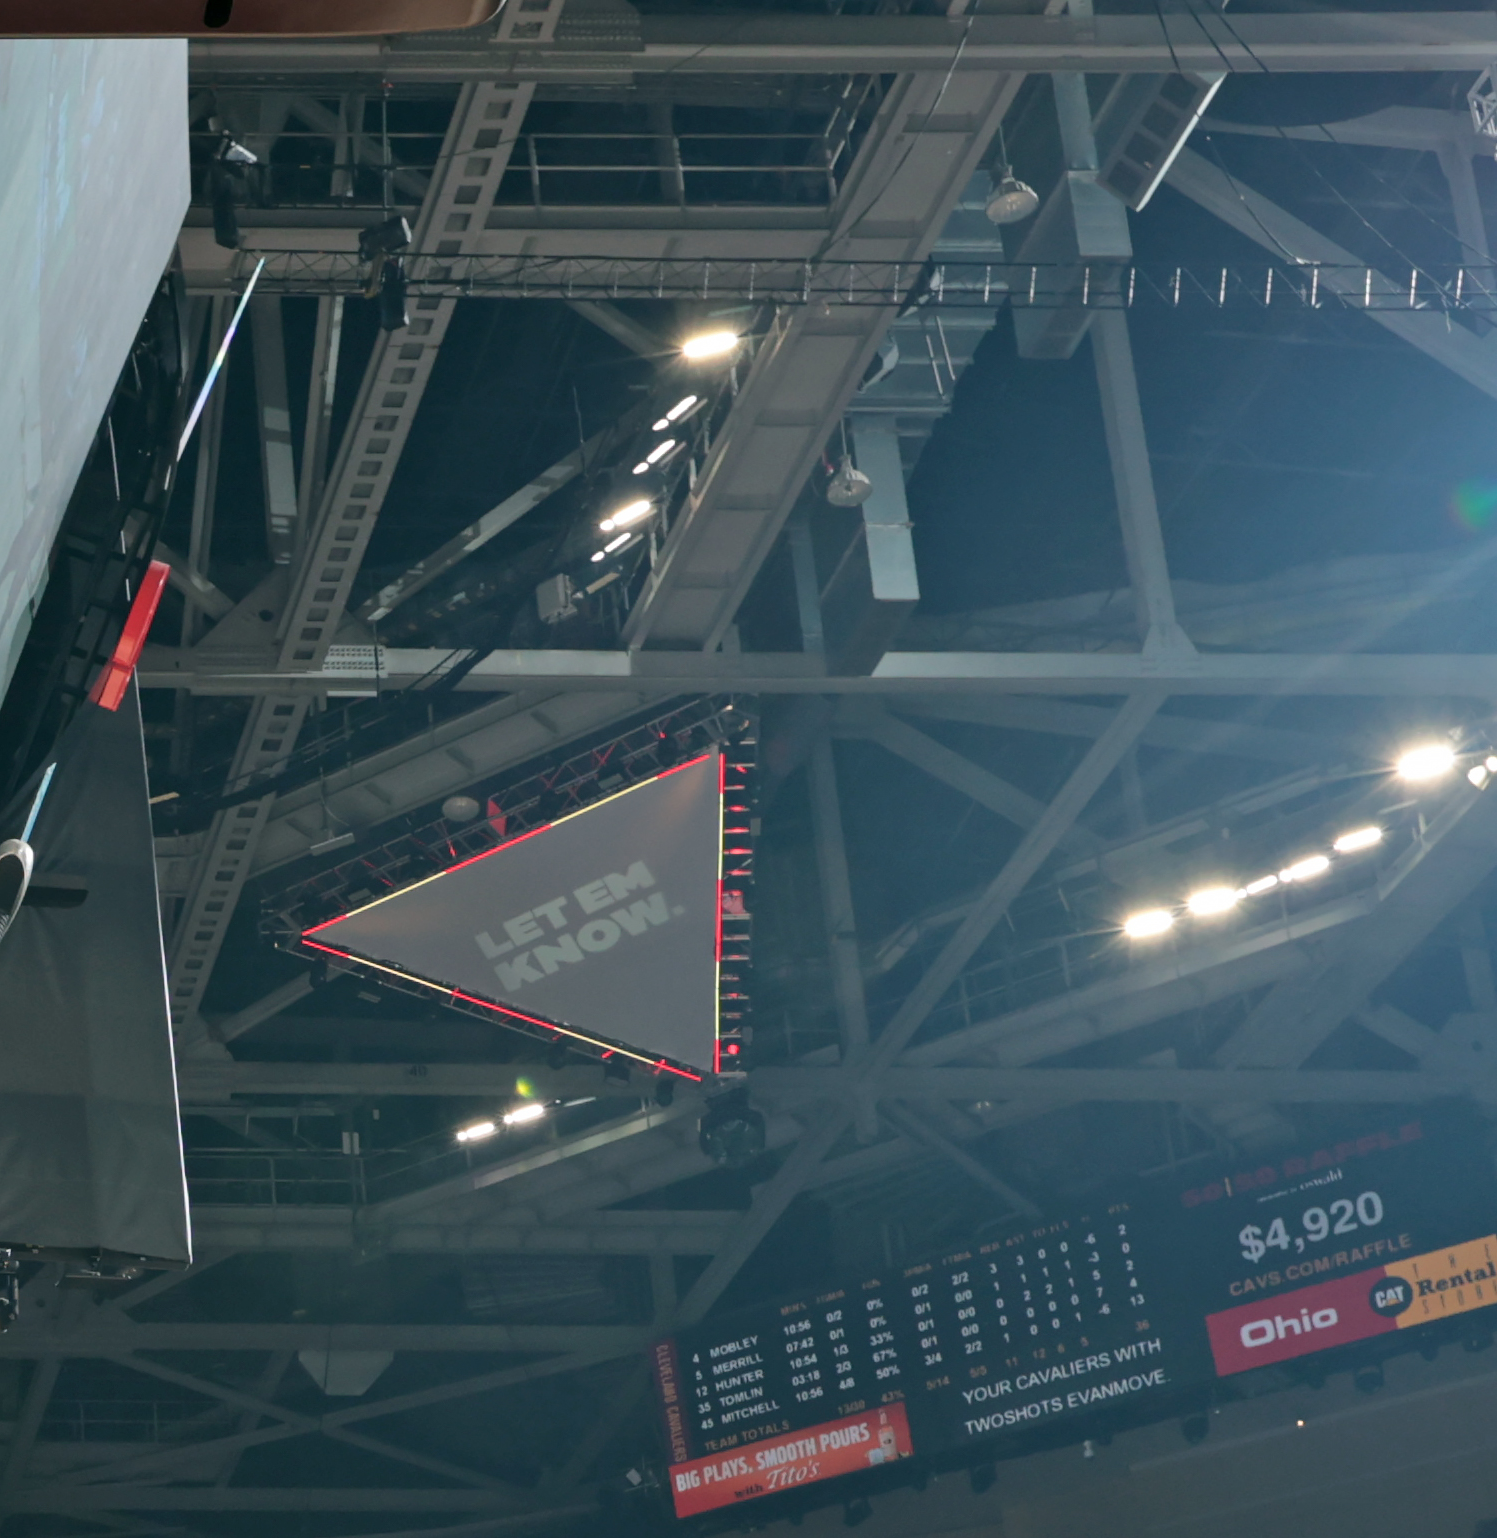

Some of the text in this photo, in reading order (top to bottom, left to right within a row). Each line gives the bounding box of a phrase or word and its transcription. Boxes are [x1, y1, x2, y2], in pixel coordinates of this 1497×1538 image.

[474, 861, 656, 960] LET EM
[1238, 1191, 1384, 1264] $4,920
[1229, 1233, 1412, 1296] CAVS.COM/RAFFLE
[1240, 1261, 1497, 1348] Ohio CAT Rental
[709, 1335, 758, 1358] MOBLEY
[712, 1353, 764, 1376] MERRILL
[715, 1370, 765, 1392] HUNTER
[963, 1338, 1162, 1405] YOUR CAVALIERS WITH
[719, 1387, 764, 1407] TOMLIN
[721, 1400, 780, 1425] MITCHELL
[964, 1396, 1064, 1435] TWOSHOTS
[675, 1422, 871, 1493] BIG PLAYS, SMOOTH POURS
[704, 1435, 738, 1451] TEAM
[766, 1459, 820, 1489] Tito's
